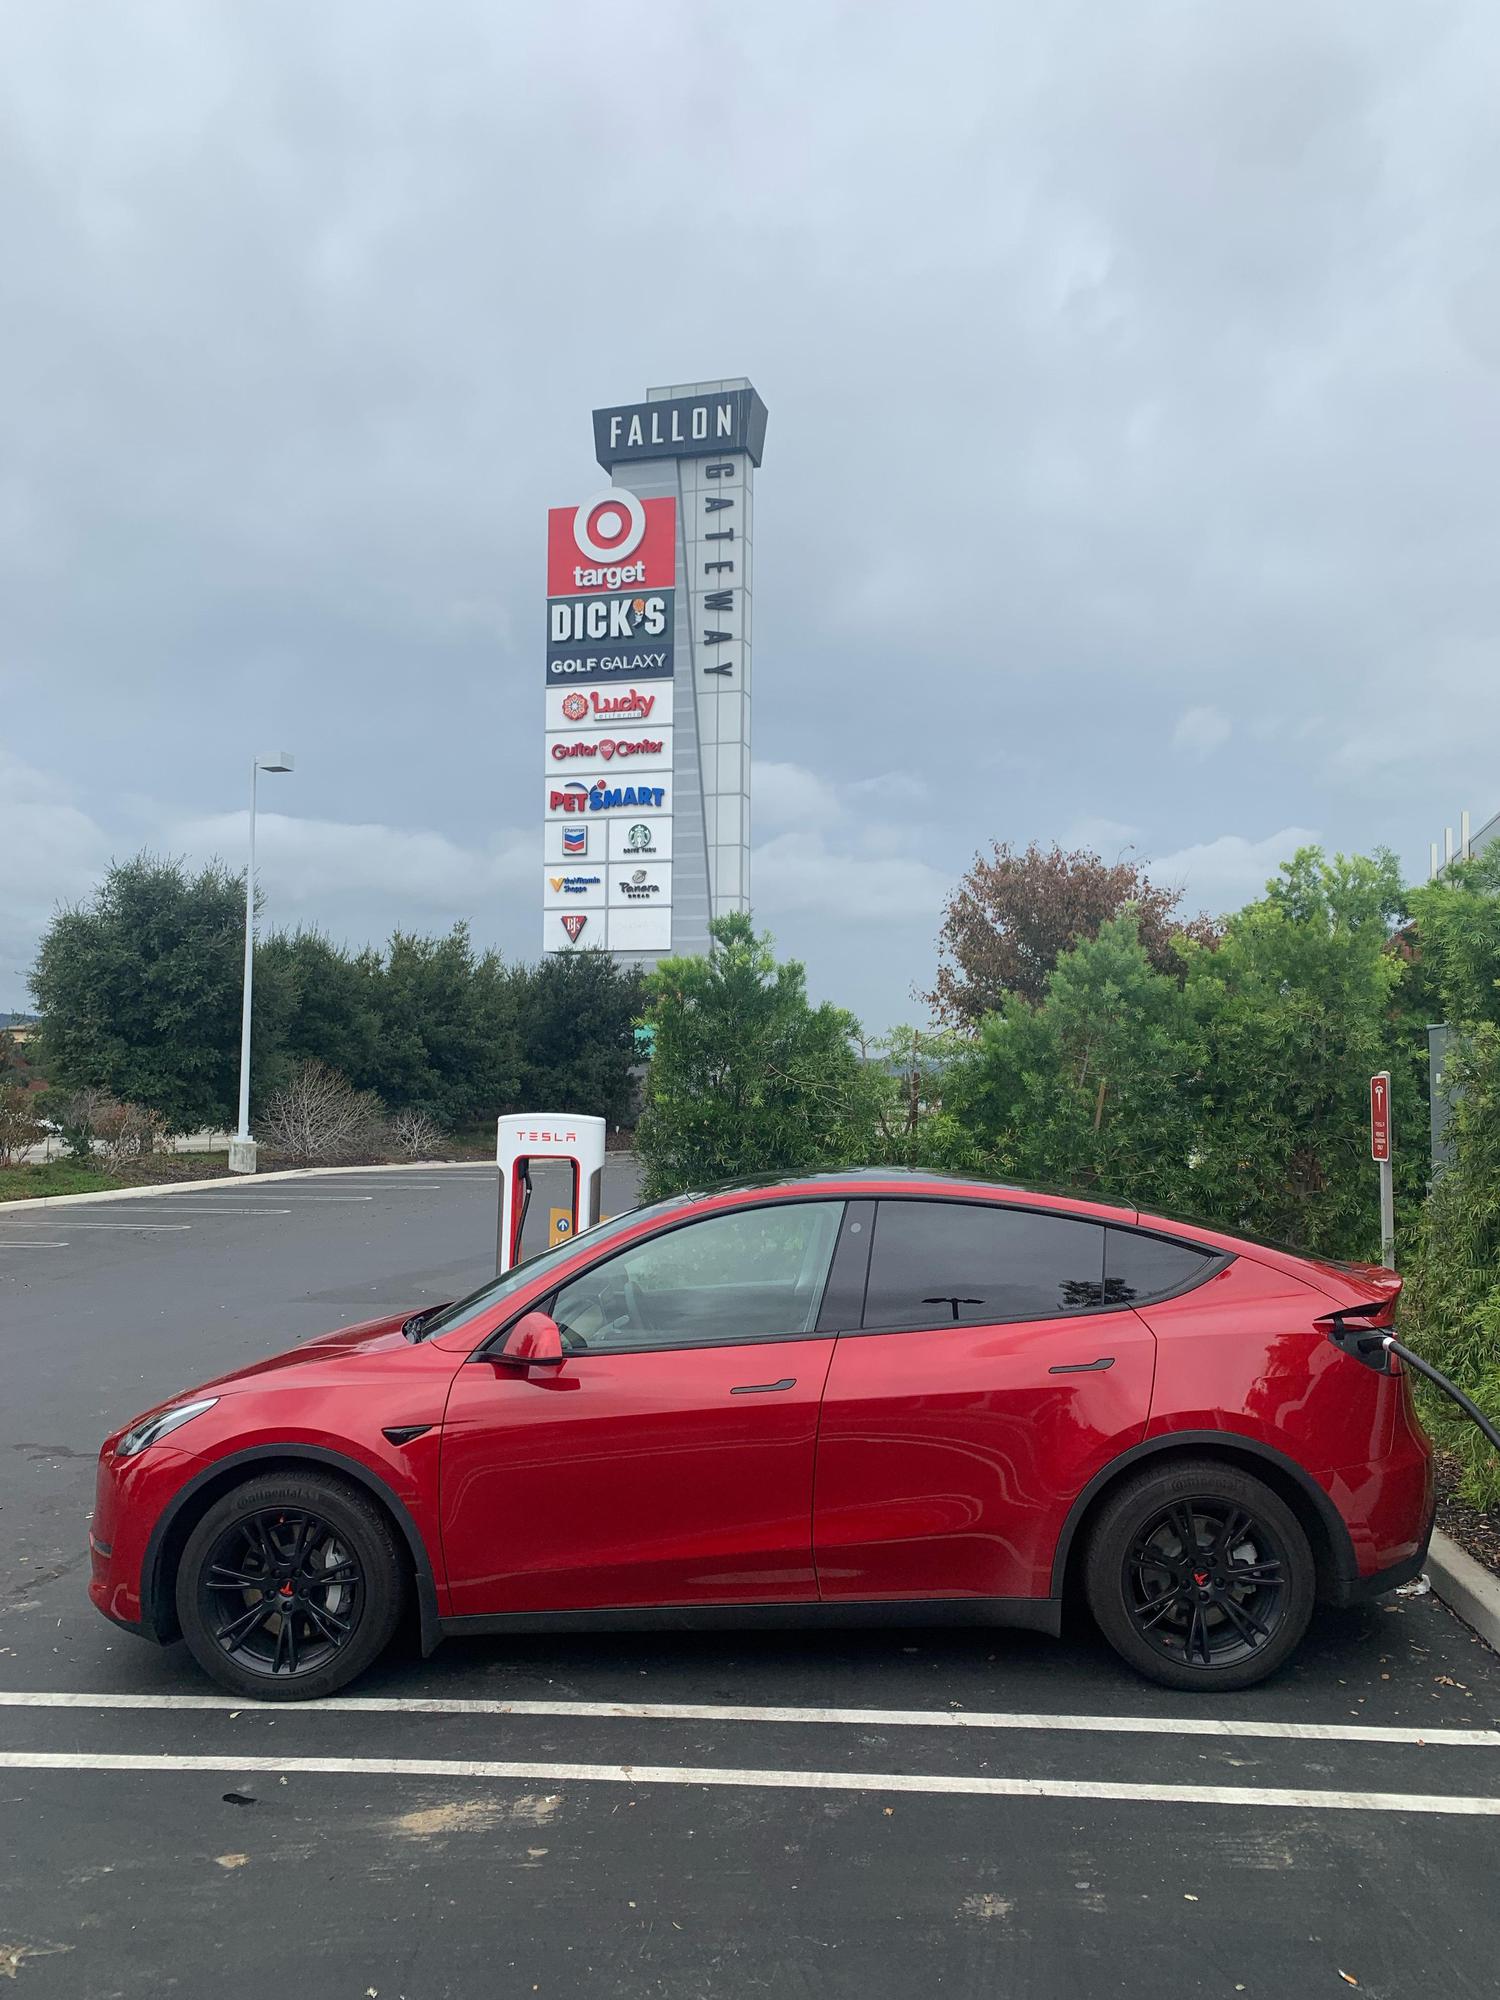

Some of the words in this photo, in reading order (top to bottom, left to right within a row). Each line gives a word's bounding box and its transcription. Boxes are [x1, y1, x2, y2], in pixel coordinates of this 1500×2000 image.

[609, 403, 733, 448] FALLON
[573, 560, 646, 590] target
[703, 462, 735, 677] GATEWAY
[551, 597, 666, 642] DICK'S
[551, 658, 598, 673] GOLF
[600, 652, 667, 670] GALAXY
[590, 688, 656, 718] Lucky
[551, 742, 598, 761] Guitar
[616, 738, 663, 757] Center
[619, 882, 660, 893] Panera
[516, 1131, 577, 1142] TESLA
